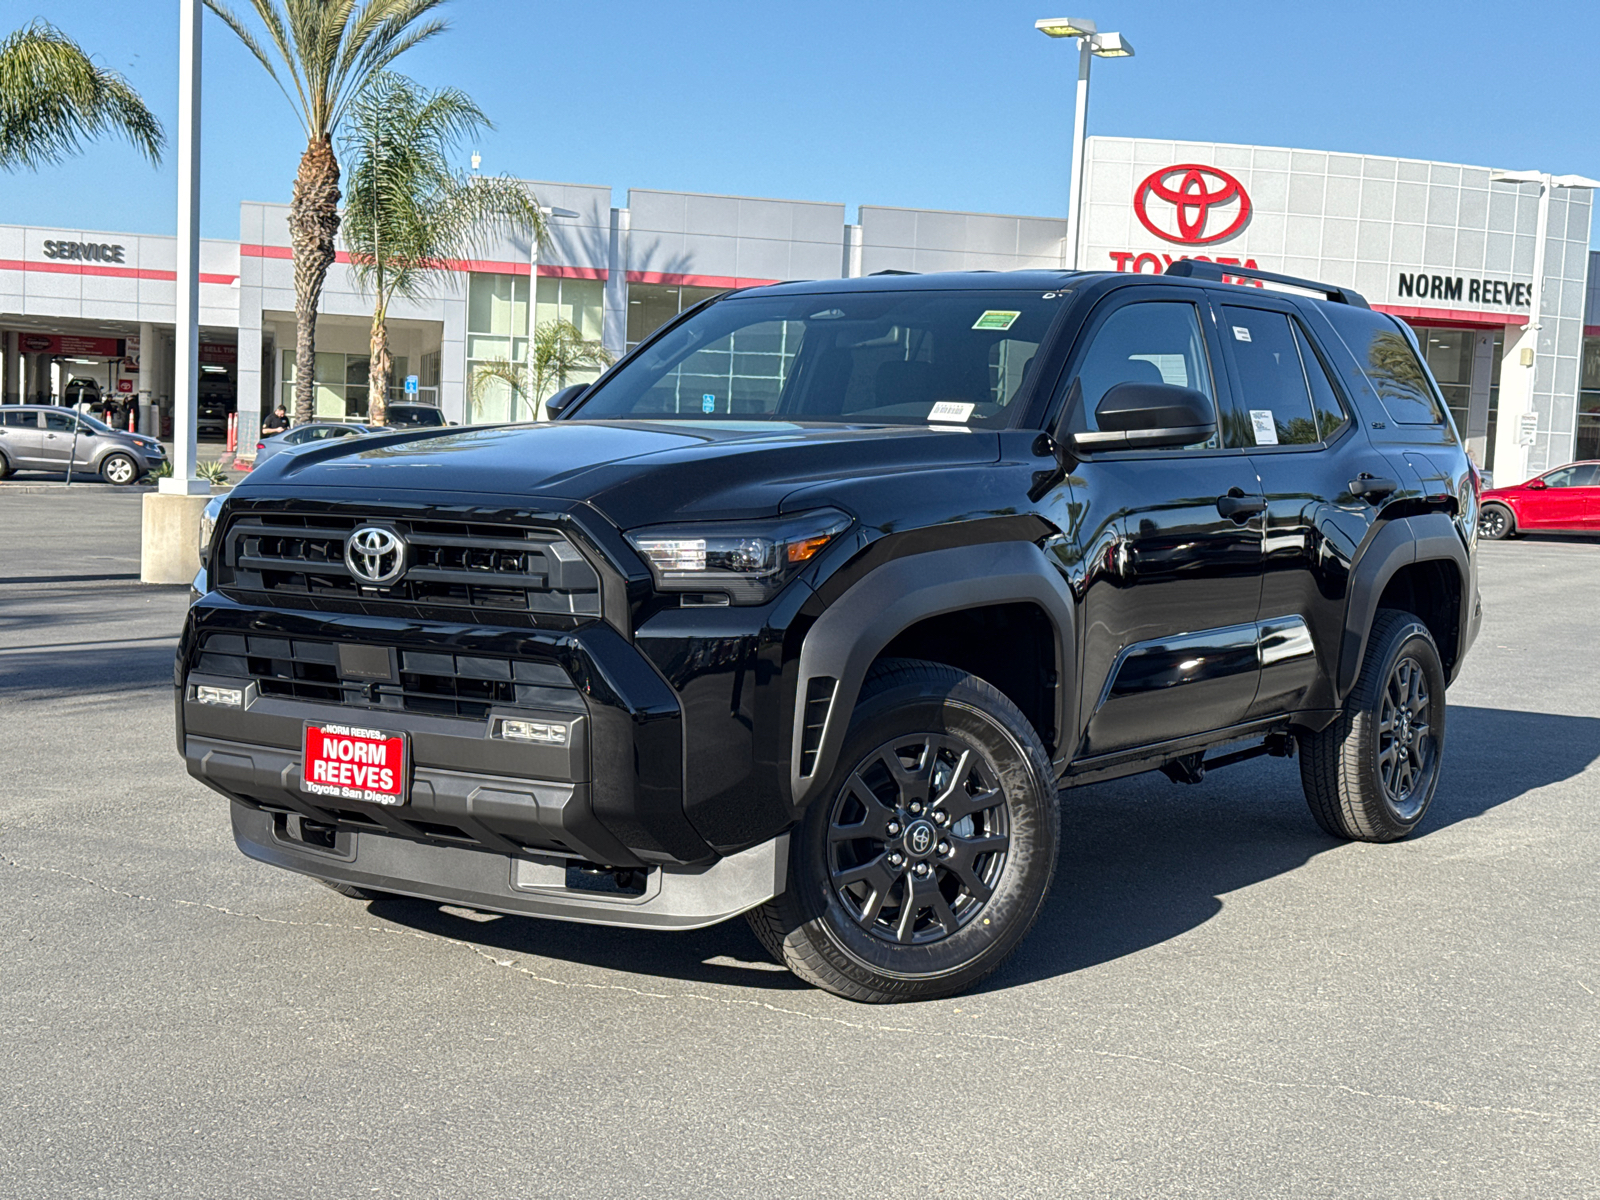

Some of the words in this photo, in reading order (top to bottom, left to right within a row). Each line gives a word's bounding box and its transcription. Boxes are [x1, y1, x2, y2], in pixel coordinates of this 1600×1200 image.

[43, 240, 125, 263] SERVICE
[1109, 252, 1264, 289] TOTA
[1398, 273, 1463, 301] NORM
[326, 724, 350, 736] NORM
[351, 728, 381, 740] REEVES
[323, 738, 386, 766] NORM
[313, 760, 393, 790] REEVES
[306, 781, 339, 795] Toyota
[341, 787, 362, 799] San
[364, 790, 396, 805] Diego
